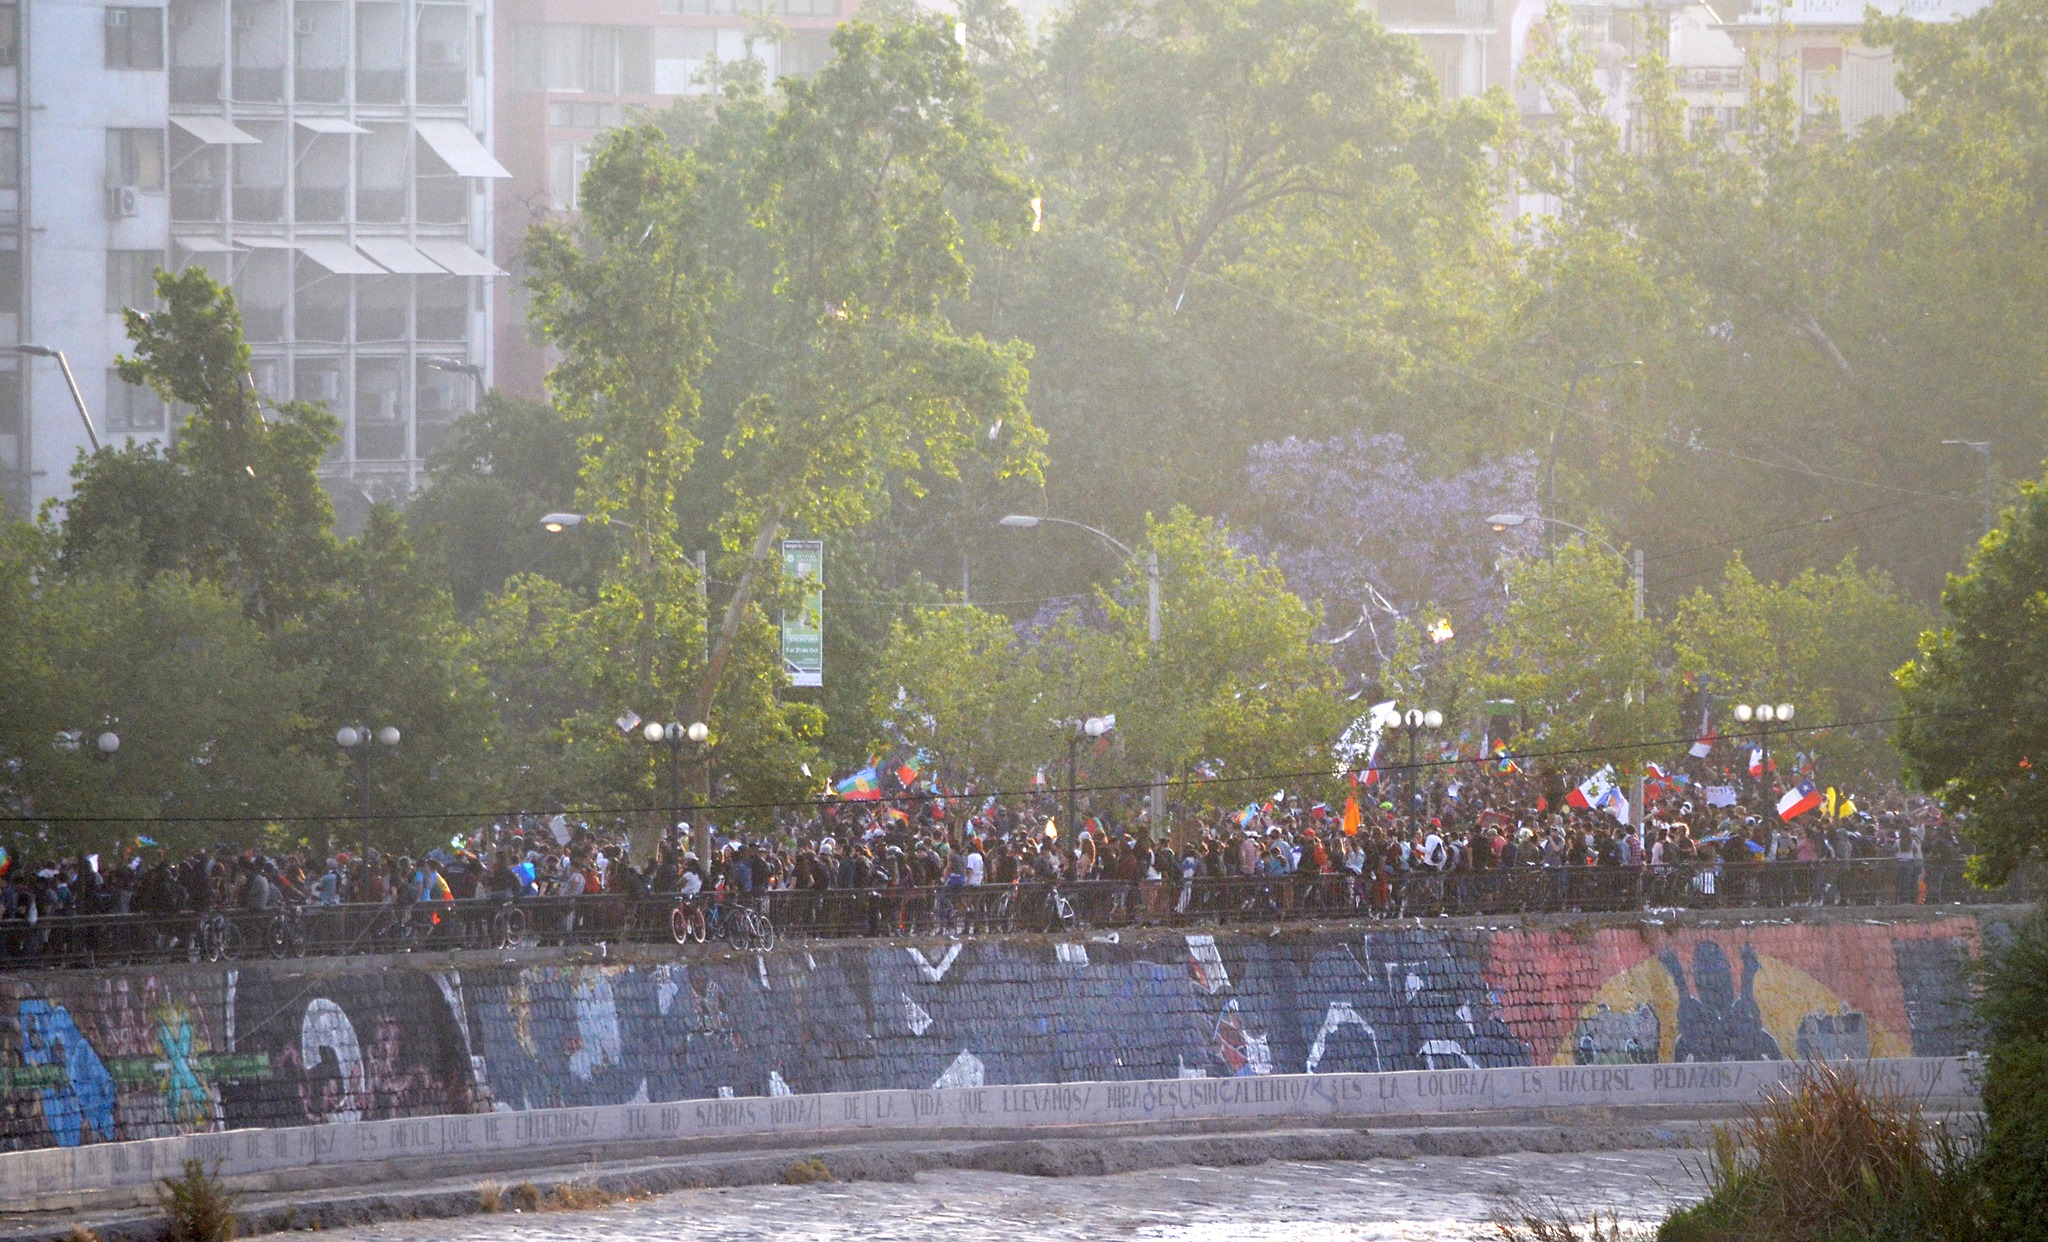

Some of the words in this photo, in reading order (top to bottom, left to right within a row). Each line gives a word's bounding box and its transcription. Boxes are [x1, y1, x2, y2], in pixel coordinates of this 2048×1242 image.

[247, 1132, 262, 1158] DE
[361, 1126, 377, 1152] ES
[449, 1119, 472, 1149] QUE
[485, 1117, 501, 1143] ME
[662, 1107, 680, 1131] NO
[844, 1096, 861, 1120] DE
[876, 1094, 895, 1119] LA
[910, 1092, 944, 1117] VIDA
[959, 1090, 988, 1115] QUE
[1379, 1075, 1400, 1100] LA
[1522, 1070, 1543, 1094] ES
[1558, 1067, 1636, 1093] HACERSE
